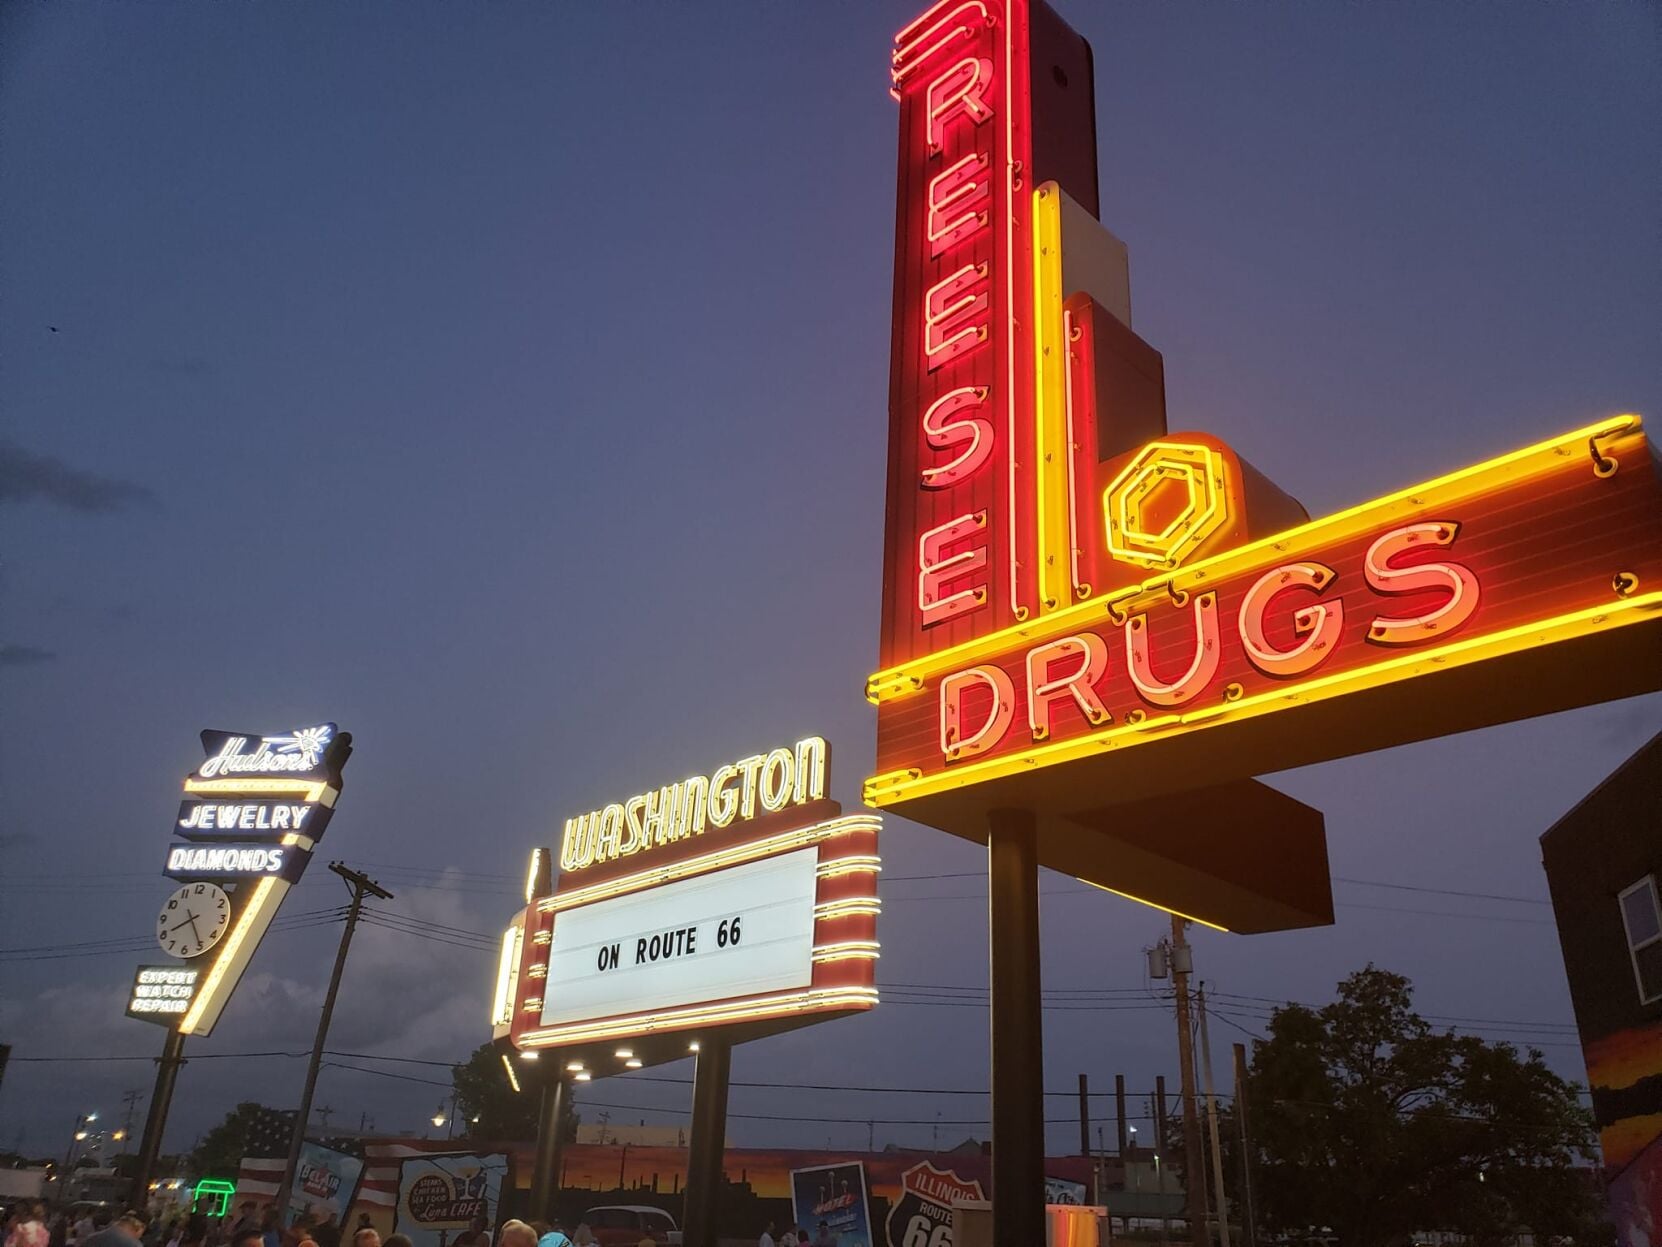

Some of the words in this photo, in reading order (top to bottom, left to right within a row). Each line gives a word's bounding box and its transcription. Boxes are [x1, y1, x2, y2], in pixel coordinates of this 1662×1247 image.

[919, 55, 995, 632] REESE
[940, 519, 1482, 765] DRUGS
[560, 736, 827, 872] WASHINGTON
[179, 804, 312, 830] JEWELRY
[166, 848, 284, 873] DIAMONDS
[180, 888, 189, 899] 11
[194, 884, 205, 895] 12
[167, 899, 178, 910] 10
[216, 898, 225, 909] 2
[160, 914, 167, 924] 9
[218, 914, 226, 925] 3
[209, 929, 217, 939] 4
[168, 940, 176, 951] 7
[180, 945, 188, 955] 6
[597, 943, 621, 972] ON
[635, 926, 697, 965] ROUTE
[716, 915, 741, 948] 66
[138, 970, 198, 984] EXPERT
[135, 984, 193, 999] WATCH
[131, 998, 188, 1012] REPAIR
[919, 1201, 952, 1225] ROUTE
